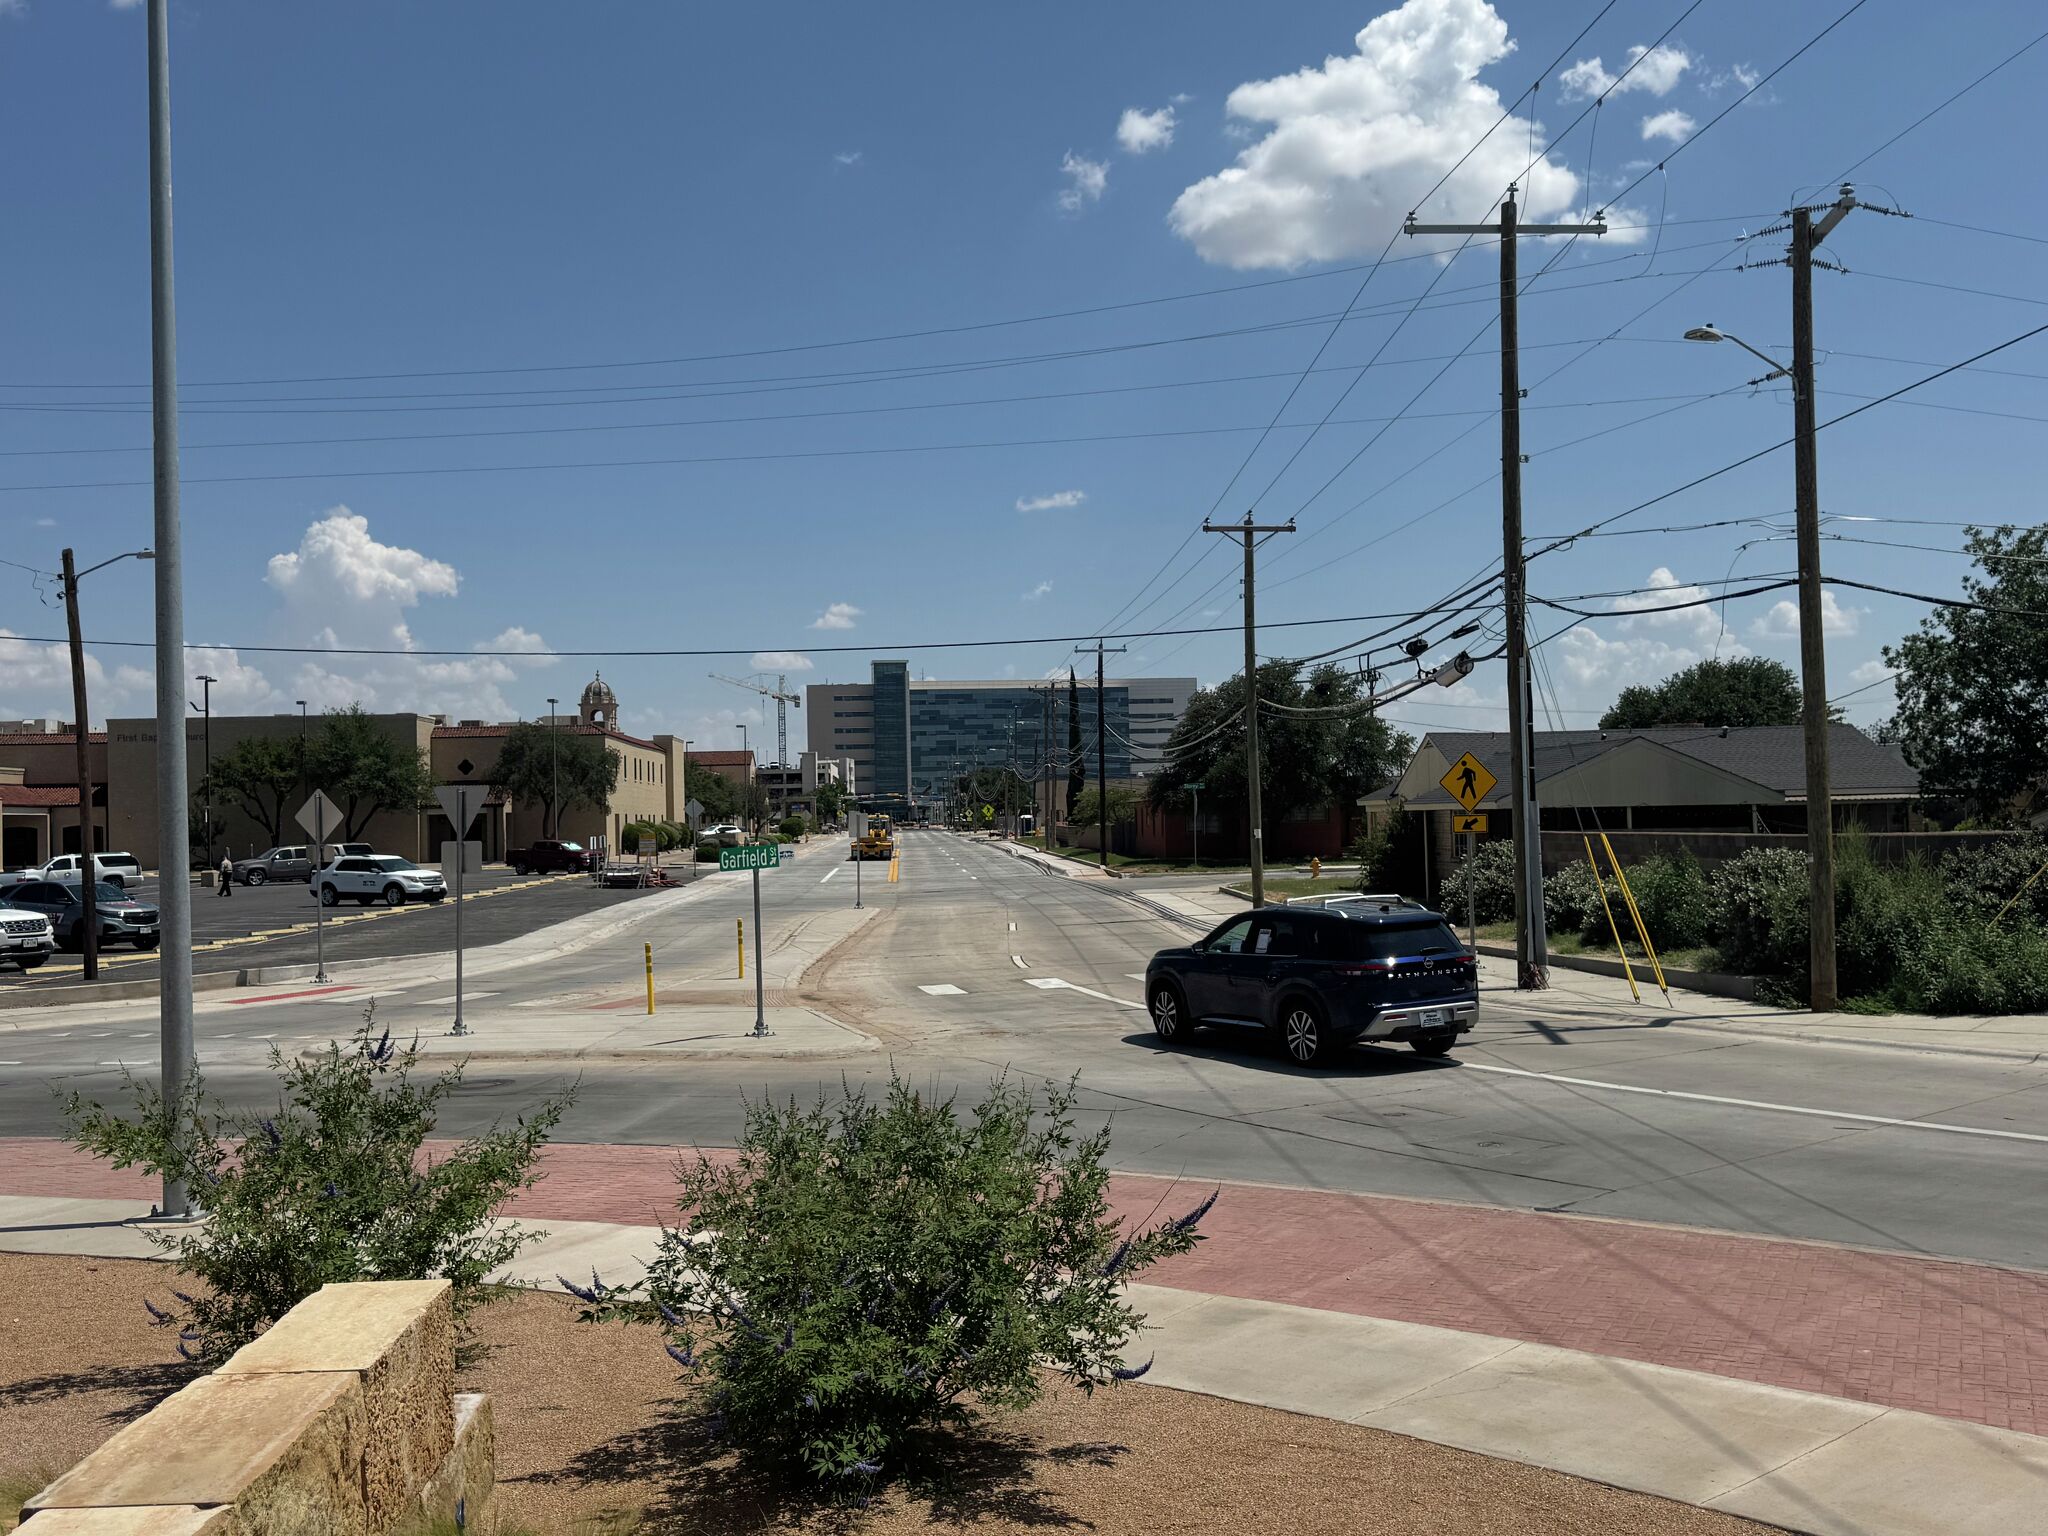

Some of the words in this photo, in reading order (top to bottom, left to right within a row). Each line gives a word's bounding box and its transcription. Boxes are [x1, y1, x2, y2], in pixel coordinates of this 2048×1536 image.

[117, 734, 137, 743] First
[721, 848, 768, 869] Garfield
[769, 847, 777, 857] St
[57, 913, 65, 924] 7
[1388, 968, 1464, 979] PATHFINDER
